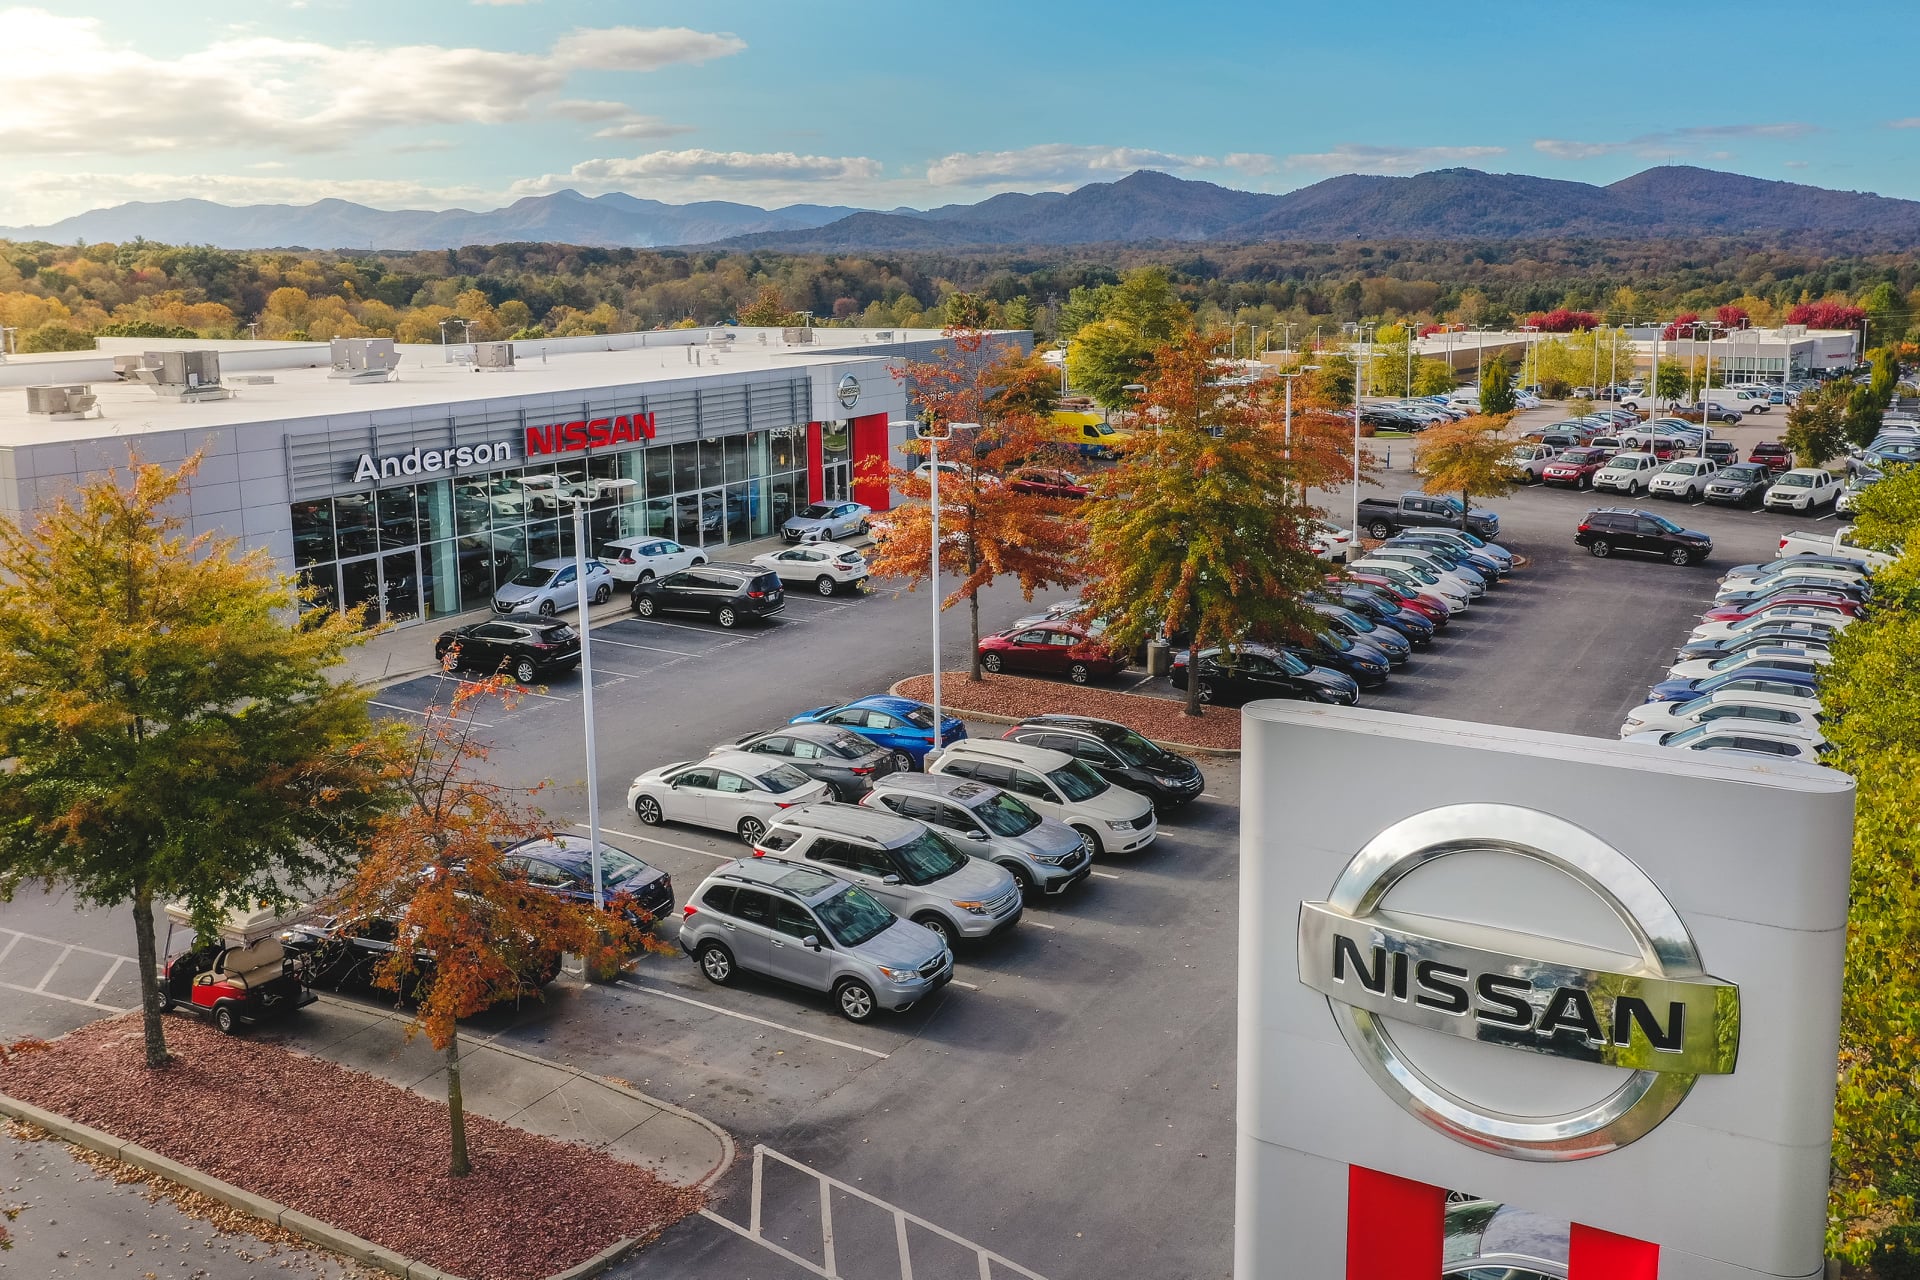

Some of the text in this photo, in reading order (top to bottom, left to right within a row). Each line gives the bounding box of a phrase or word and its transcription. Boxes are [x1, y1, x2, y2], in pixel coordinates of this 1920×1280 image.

[353, 412, 656, 482] Anderson NISSAN
[1332, 934, 1686, 1053] NISSAN
